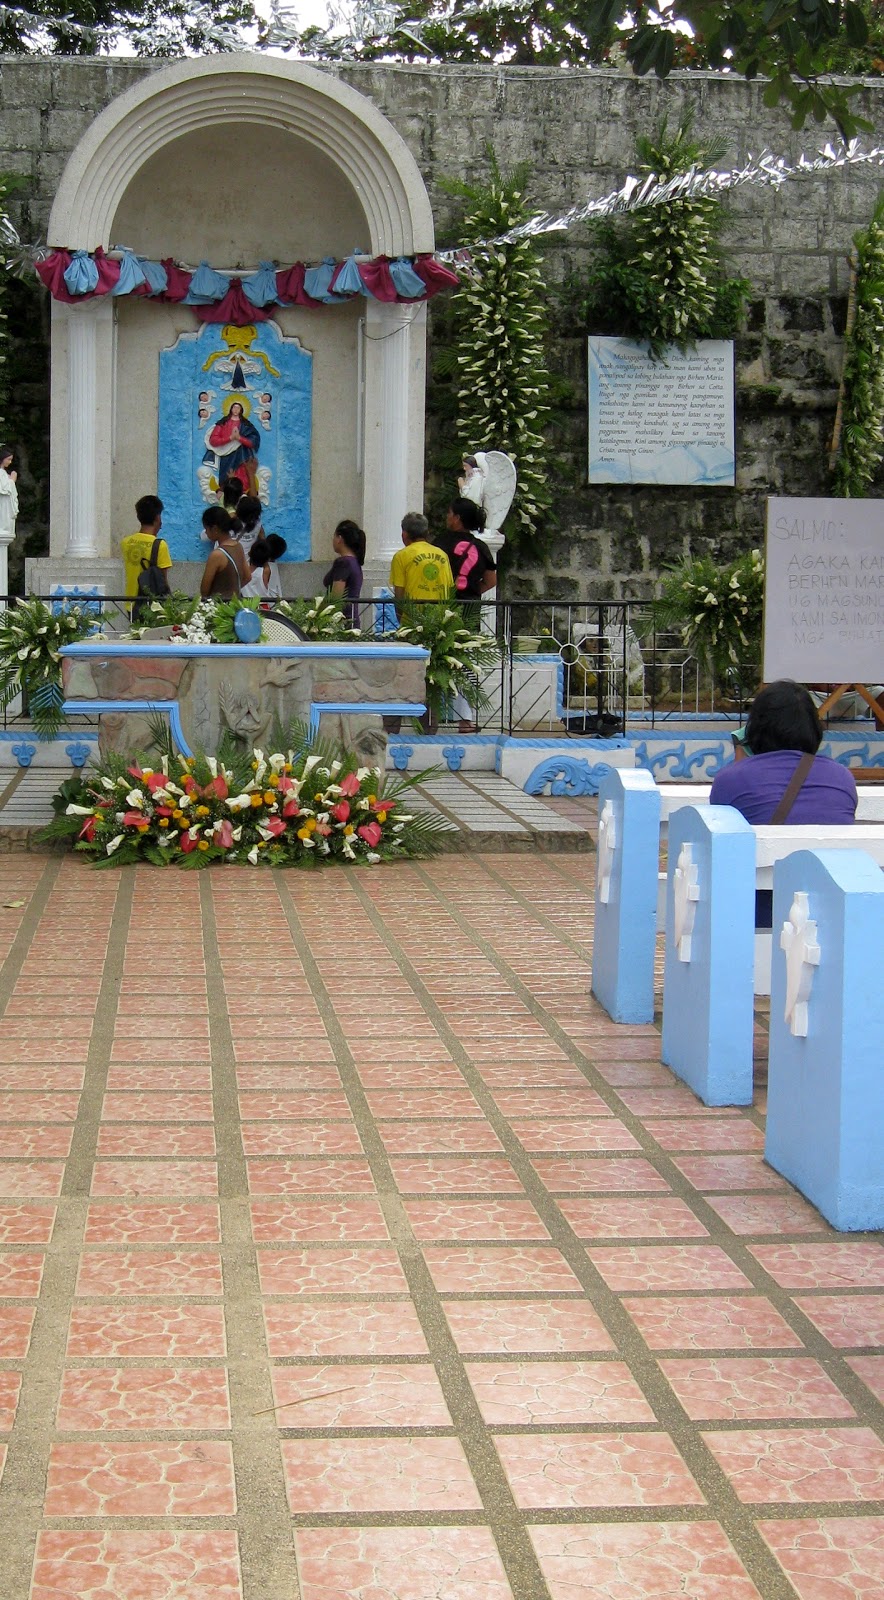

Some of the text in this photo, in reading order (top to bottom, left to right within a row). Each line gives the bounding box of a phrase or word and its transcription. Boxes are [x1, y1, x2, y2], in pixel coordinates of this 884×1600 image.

[771, 517, 845, 541] SALMO:
[786, 554, 851, 571] AGAKA
[789, 595, 811, 608] UG
[791, 612, 824, 627] KAMI
[830, 611, 849, 626] SA
[794, 631, 825, 645] MGA
